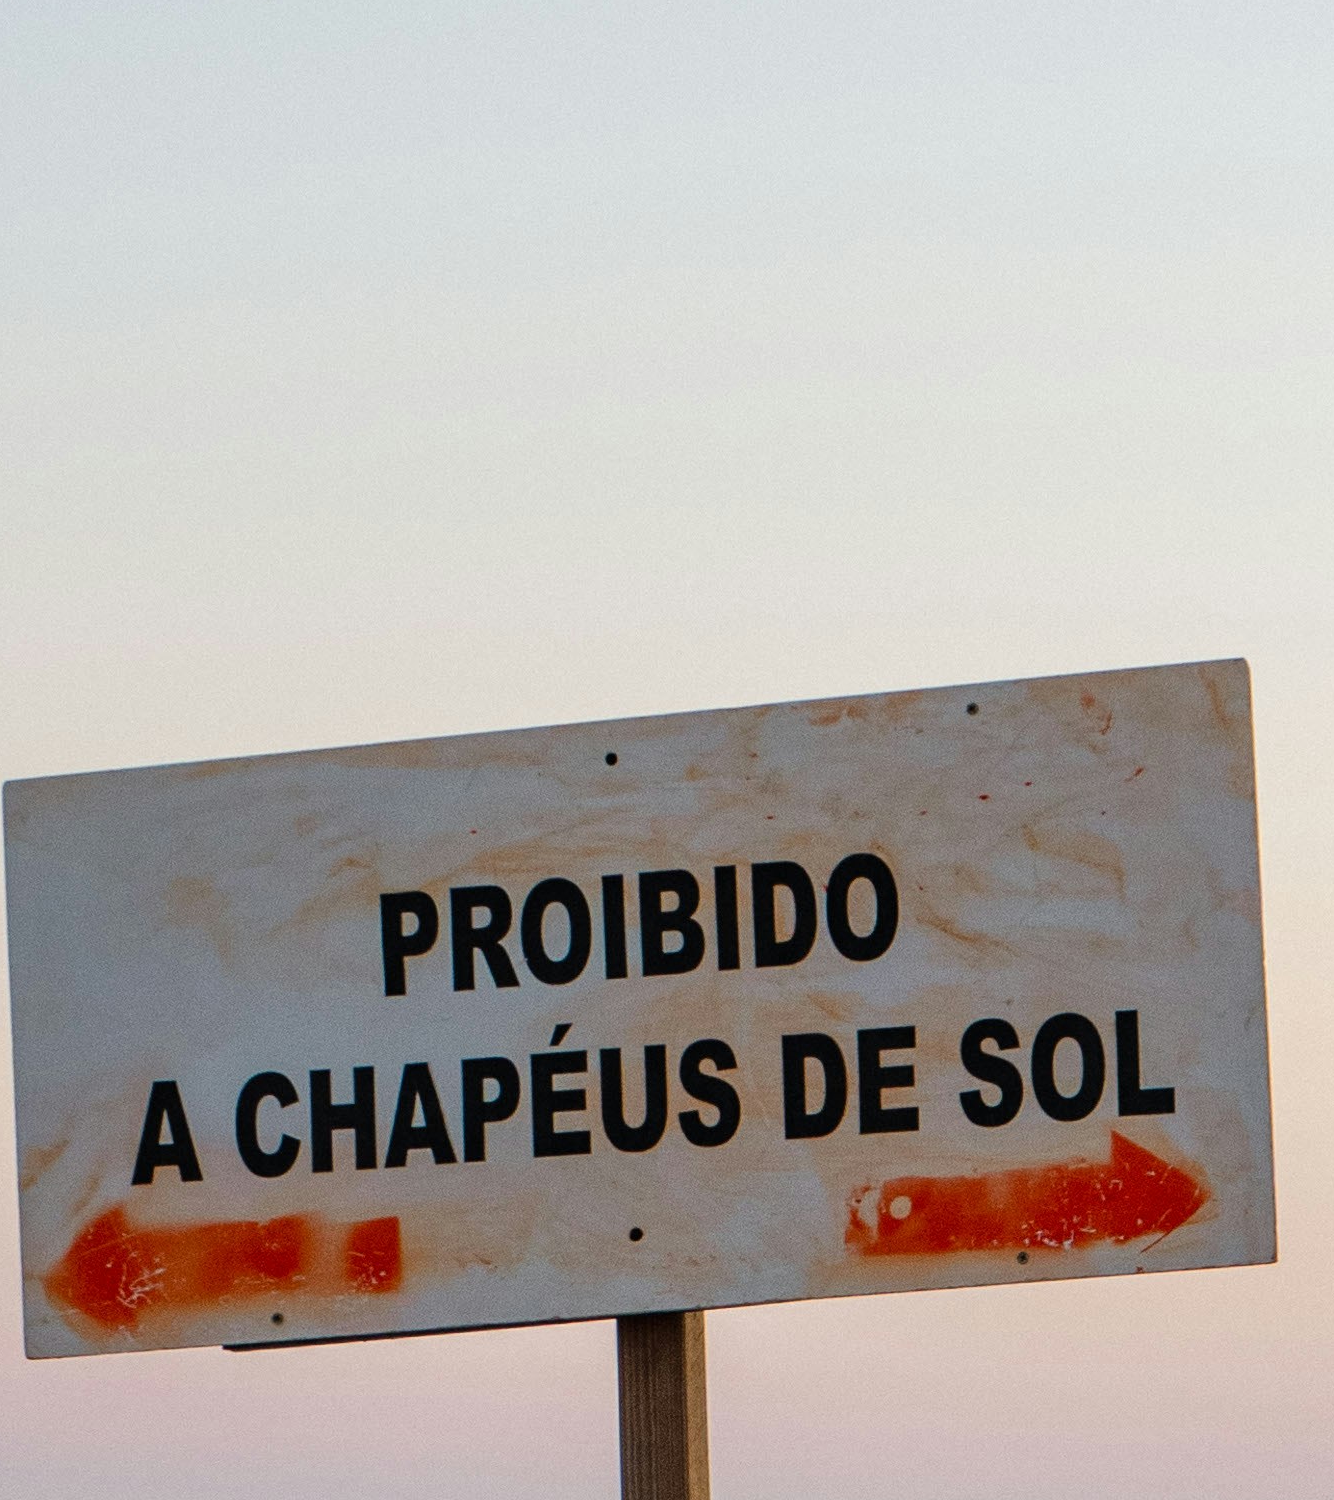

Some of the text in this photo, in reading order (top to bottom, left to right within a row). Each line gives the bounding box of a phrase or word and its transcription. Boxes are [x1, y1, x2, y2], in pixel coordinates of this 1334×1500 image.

[378, 852, 900, 998] PROIBIDO
[130, 1008, 1177, 1187] A CHAPÉUS DE SOL
